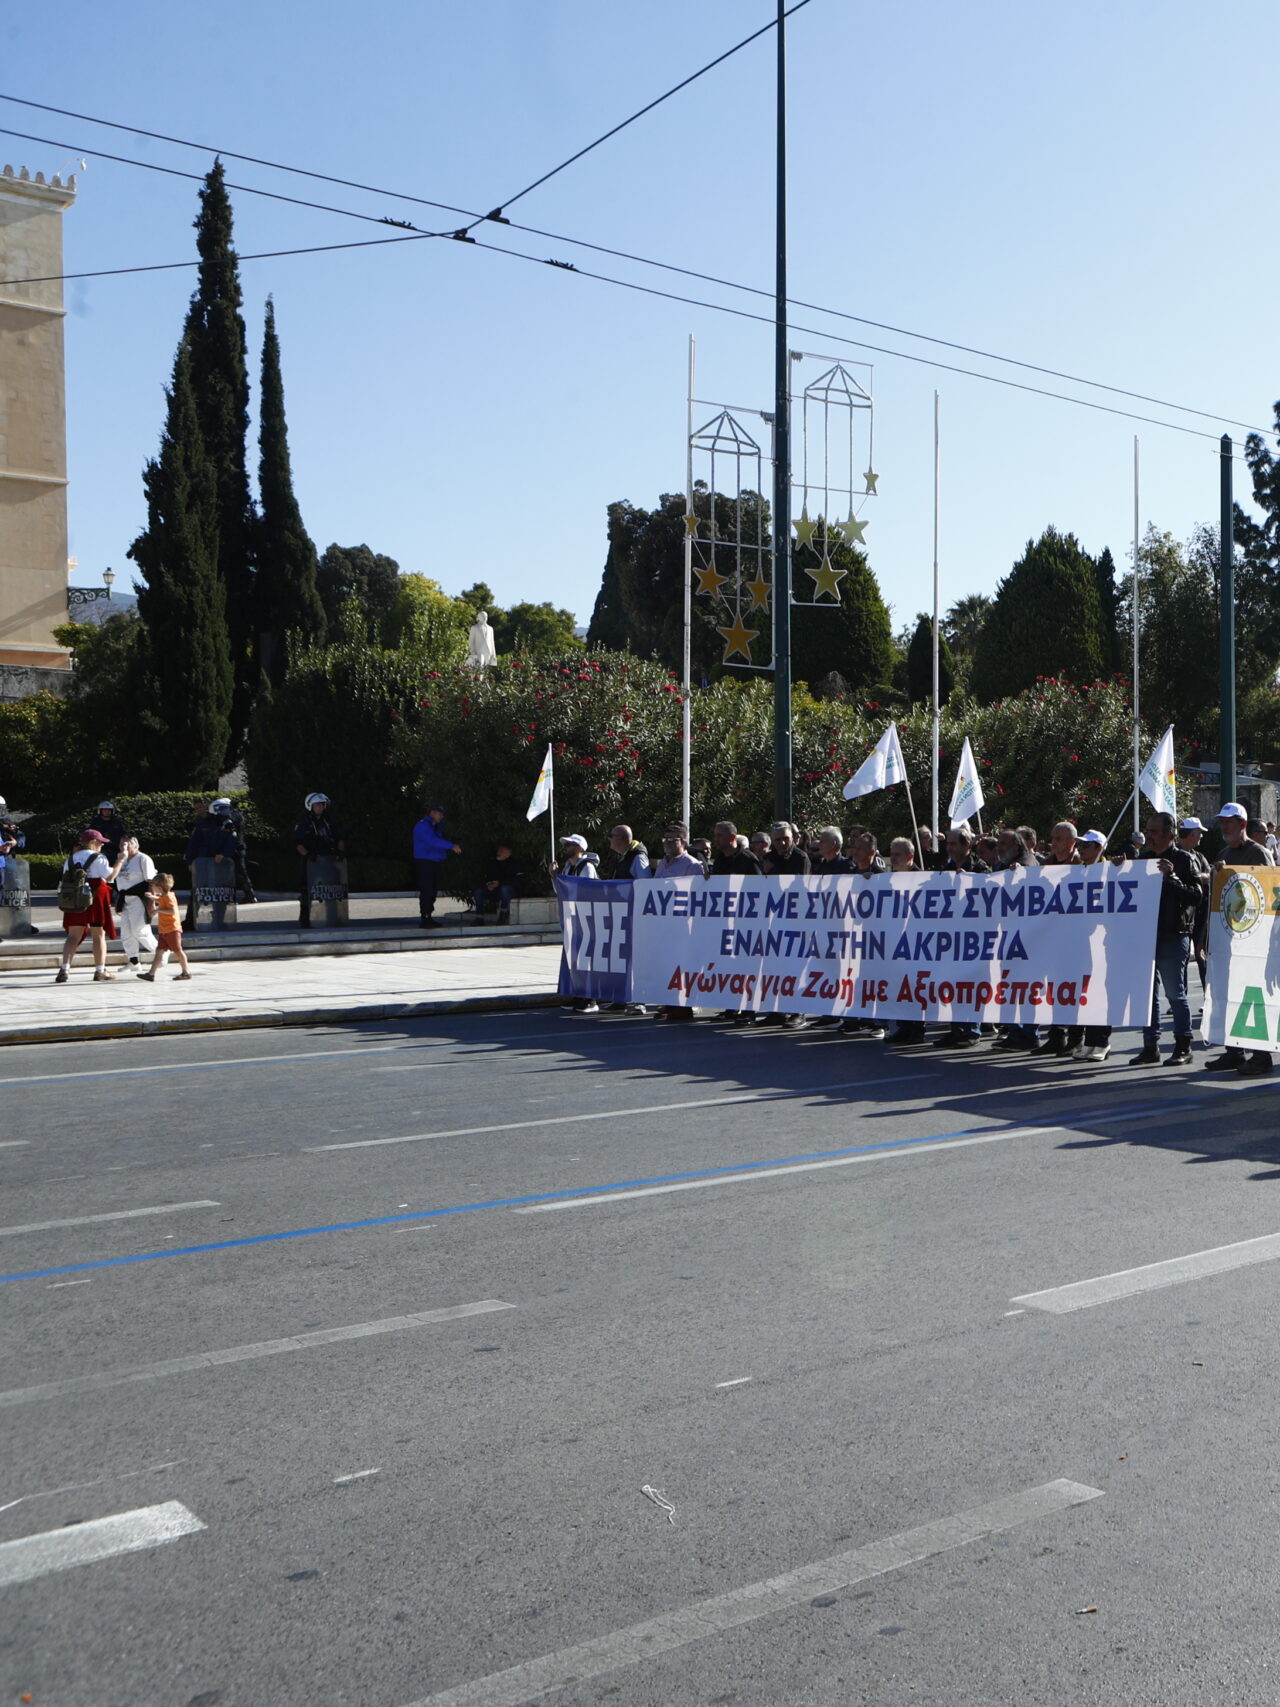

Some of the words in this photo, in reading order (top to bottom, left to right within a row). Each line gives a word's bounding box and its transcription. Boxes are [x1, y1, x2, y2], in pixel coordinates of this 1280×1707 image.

[642, 890, 760, 918] ΑΥΞΗΣΕΙΣ
[765, 891, 800, 919] ΜΕ
[804, 889, 956, 919] ΣΥΛΛΟΓΙΚΕΣ
[962, 881, 1139, 918] ΣΥΜΒΑΣΕΙΣ
[562, 901, 629, 974] ΓΣΕΕ
[720, 929, 820, 960] ΕΝΑΝΤΙΑ
[825, 931, 886, 961] ΣΤΗΝ
[892, 929, 1029, 961] ΑΚΡΙΒΕΙΑ
[667, 962, 756, 1000] Αγώνας
[760, 974, 797, 1001] για
[802, 968, 854, 1008] Ζωή
[861, 979, 889, 1008] με
[896, 970, 1092, 1012] Αξιοπρέπεια!
